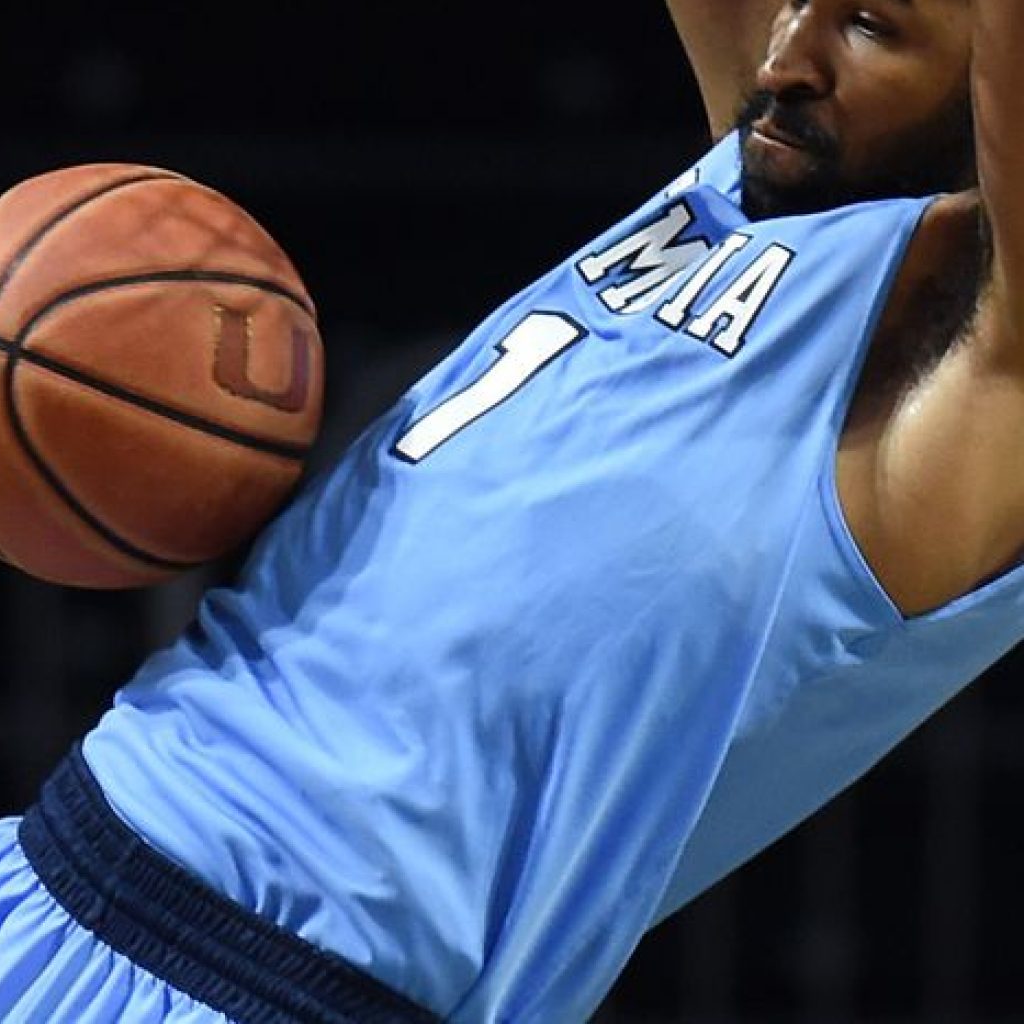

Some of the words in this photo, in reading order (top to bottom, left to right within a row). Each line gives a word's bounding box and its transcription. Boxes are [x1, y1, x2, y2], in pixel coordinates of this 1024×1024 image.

[574, 169, 797, 358] MIA
[213, 304, 310, 412] U
[390, 310, 589, 464] 1
